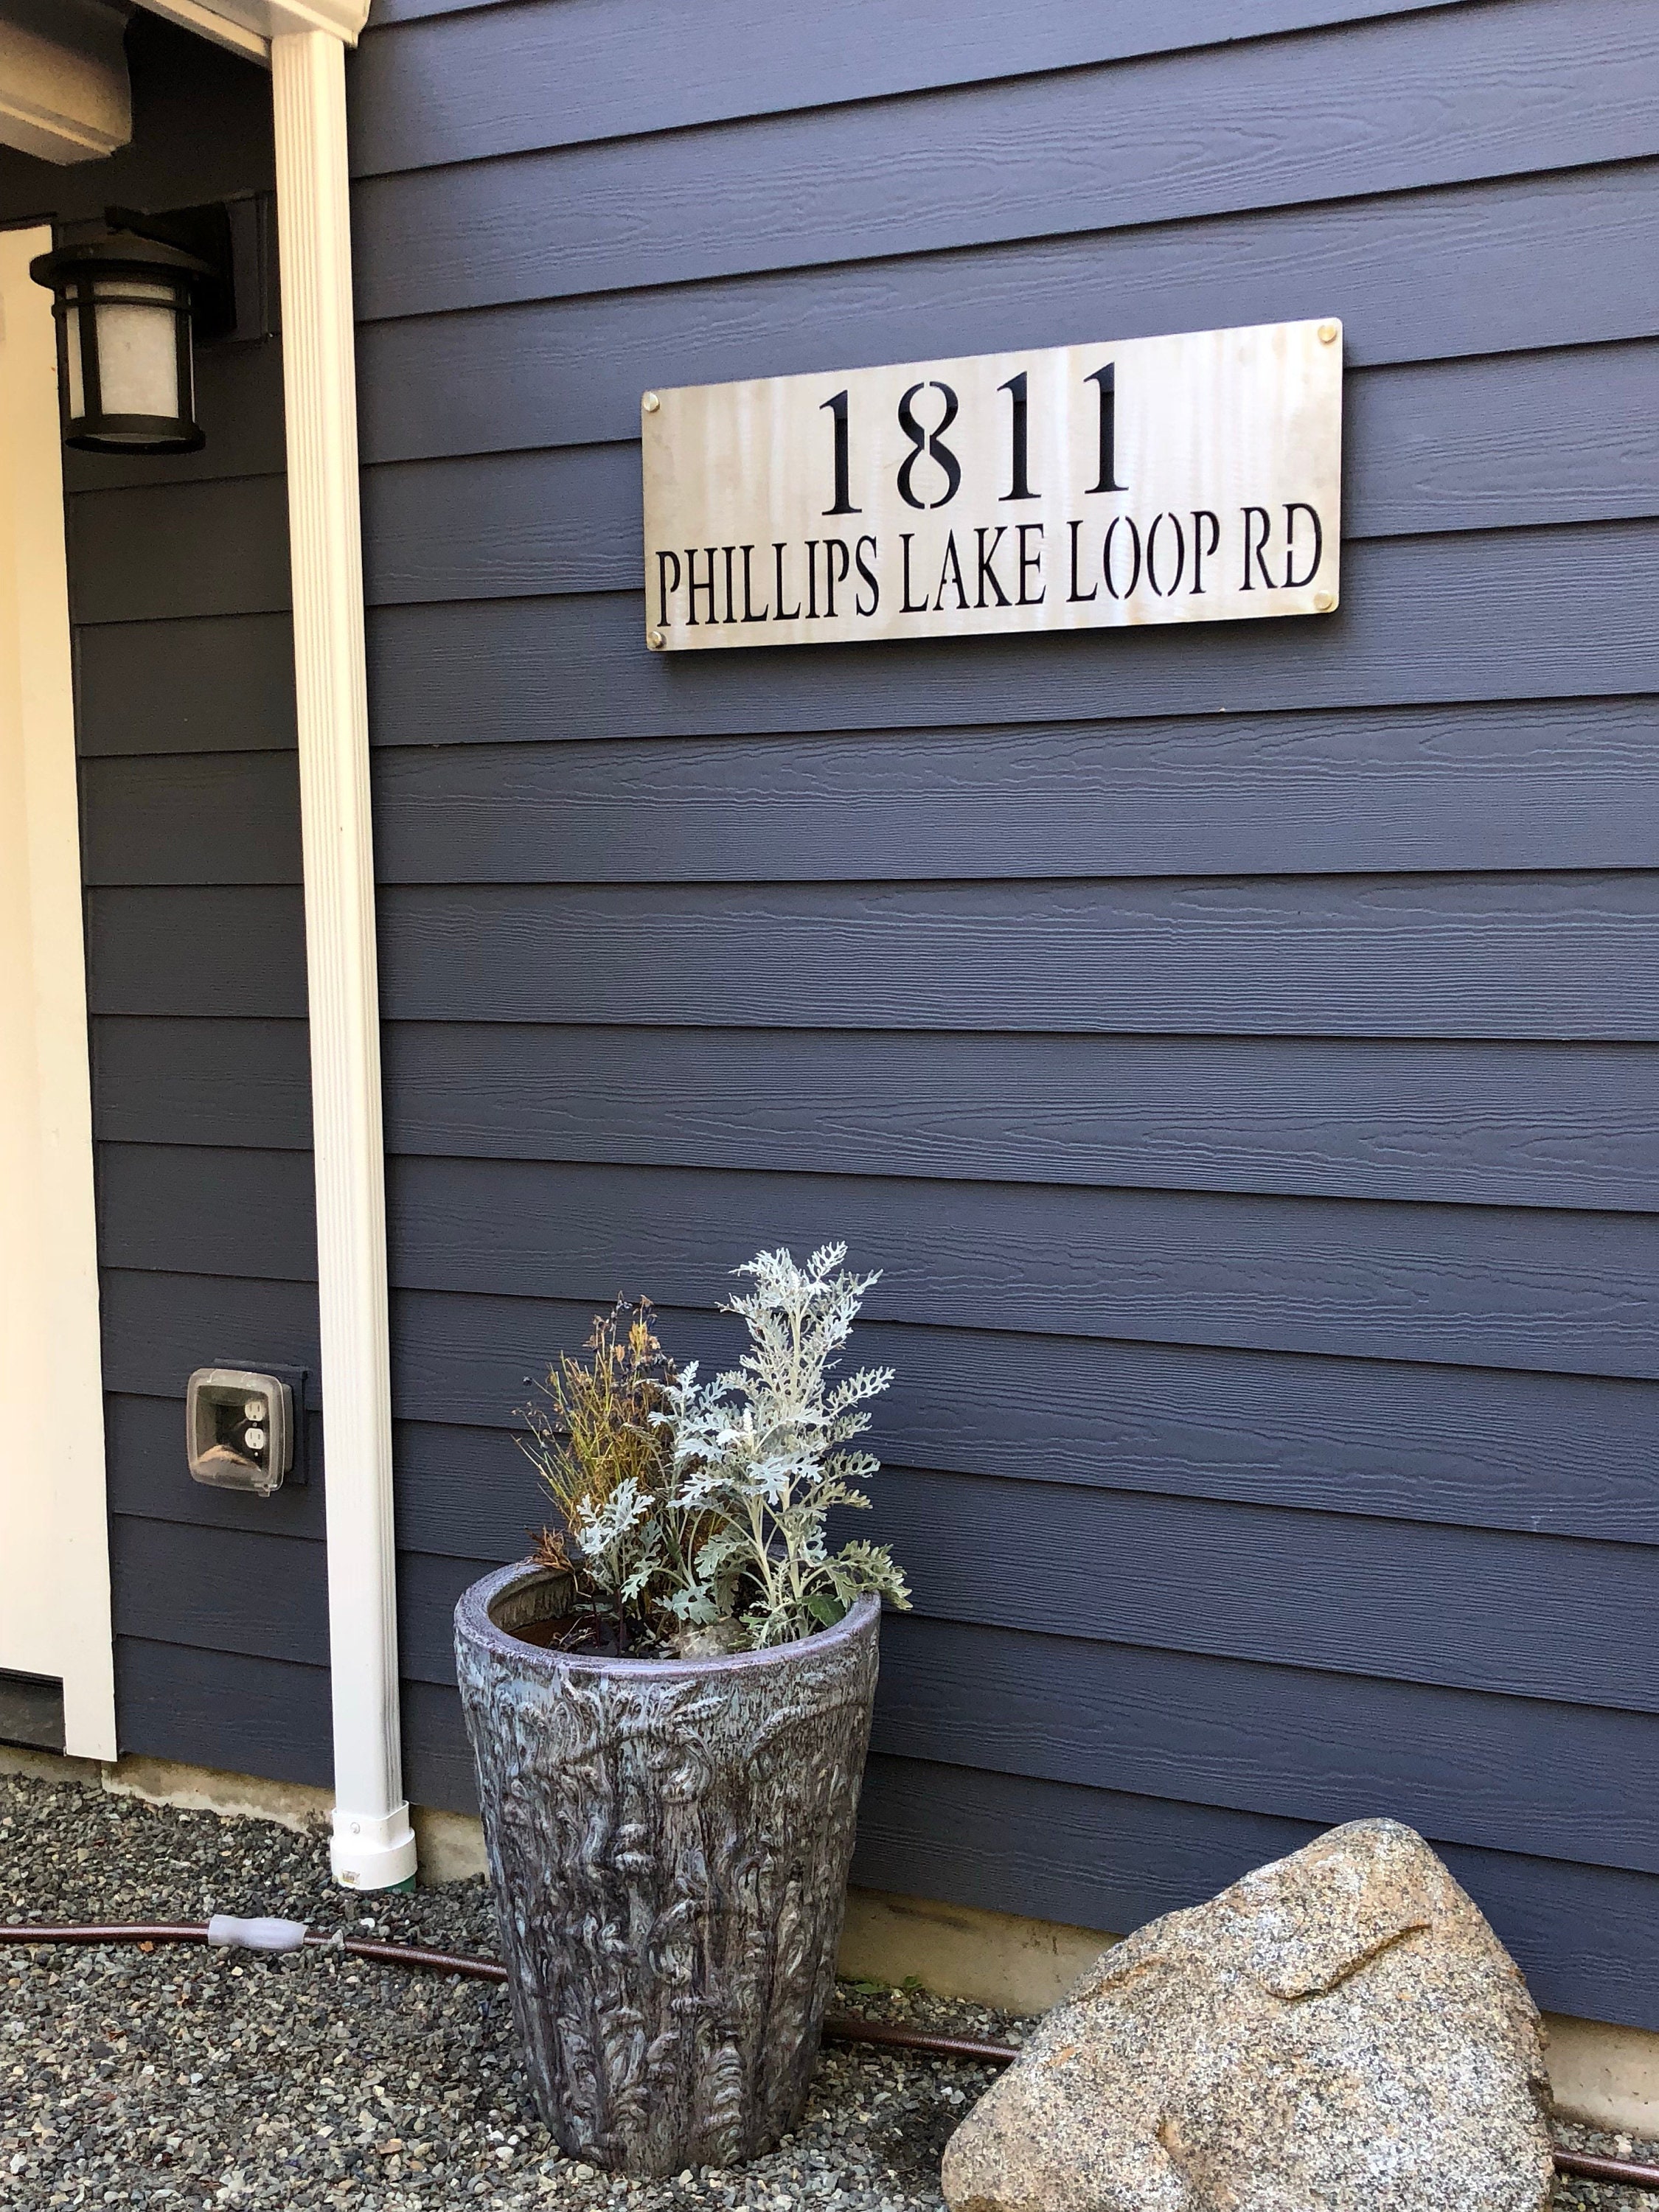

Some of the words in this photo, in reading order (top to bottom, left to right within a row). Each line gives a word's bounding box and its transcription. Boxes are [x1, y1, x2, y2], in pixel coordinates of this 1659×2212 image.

[818, 361, 1129, 515] 1811
[655, 535, 880, 627] PHILLIPS
[899, 523, 1046, 613] LAKE
[1066, 509, 1220, 602] LOOP
[1240, 503, 1323, 591] RD
